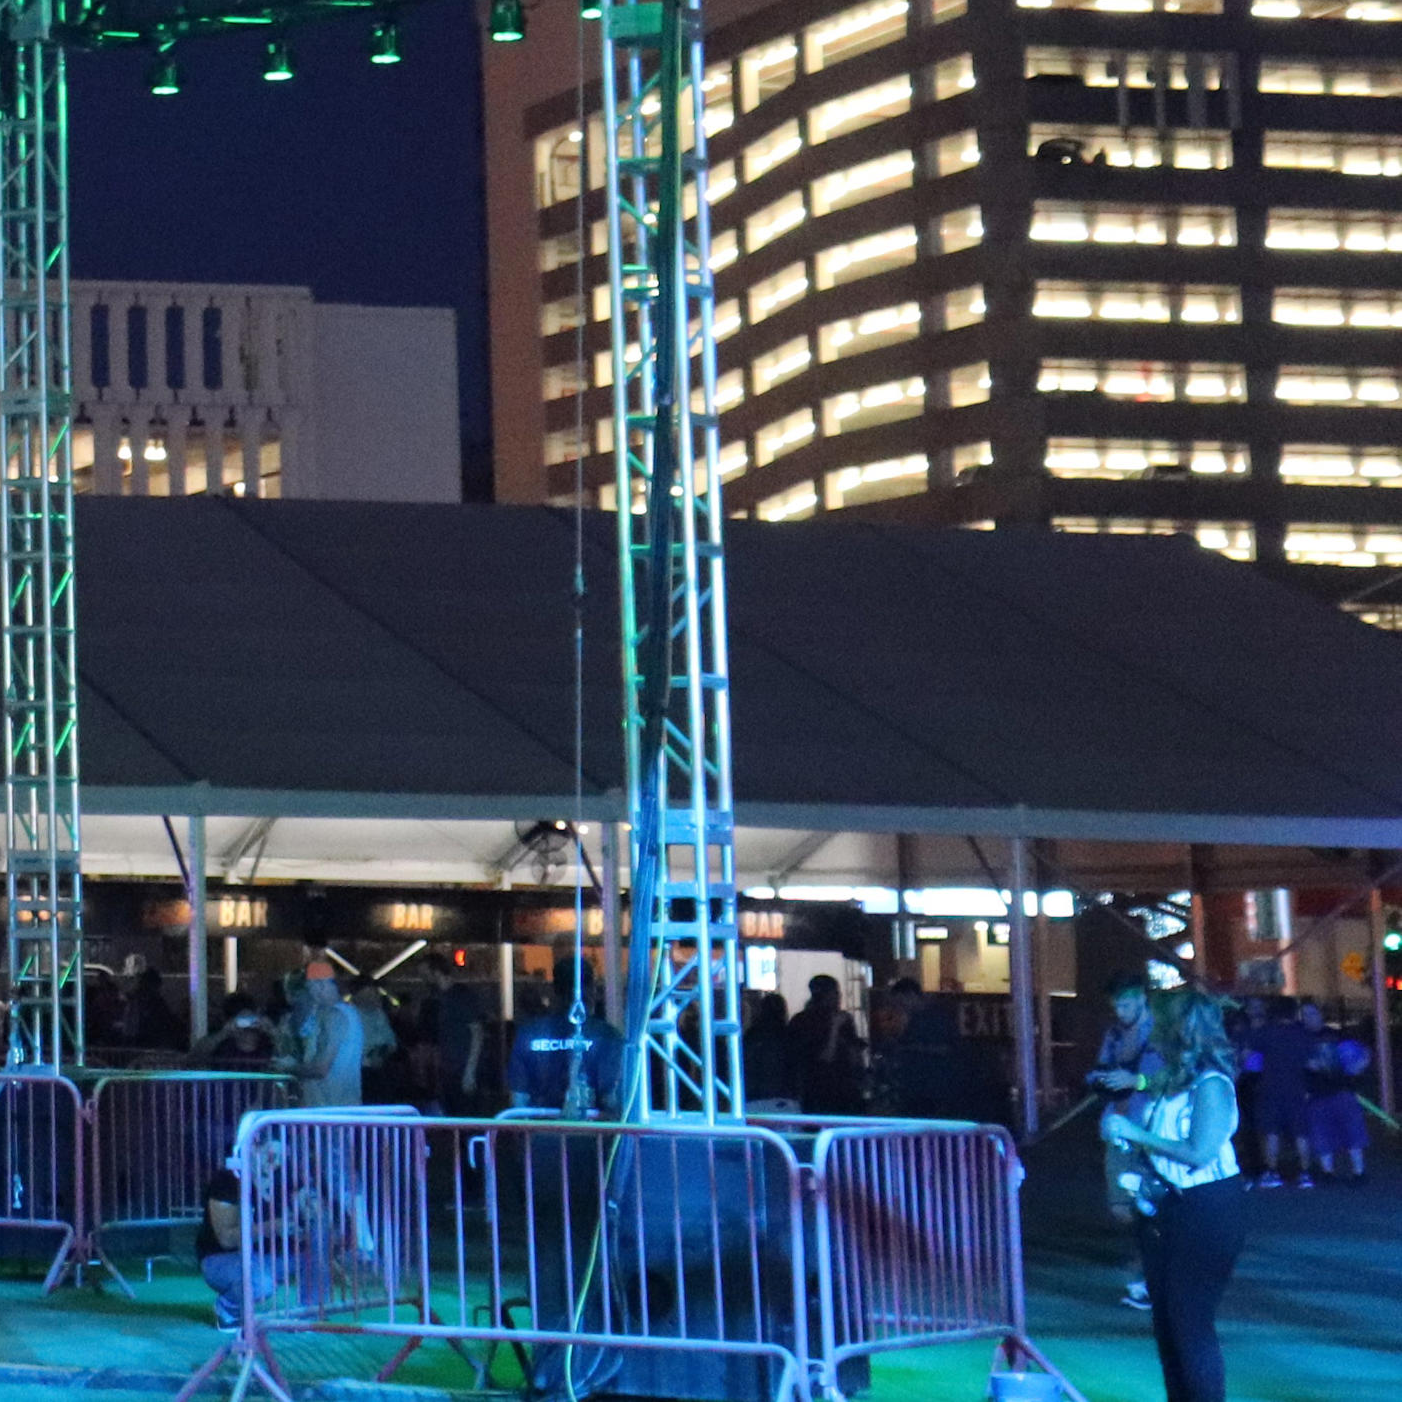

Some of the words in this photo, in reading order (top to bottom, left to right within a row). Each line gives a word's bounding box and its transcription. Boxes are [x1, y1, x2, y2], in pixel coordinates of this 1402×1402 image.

[219, 895, 268, 927] BAR
[392, 903, 434, 931] BAR
[743, 911, 784, 939] BAR
[531, 1038, 594, 1052] SECURY
